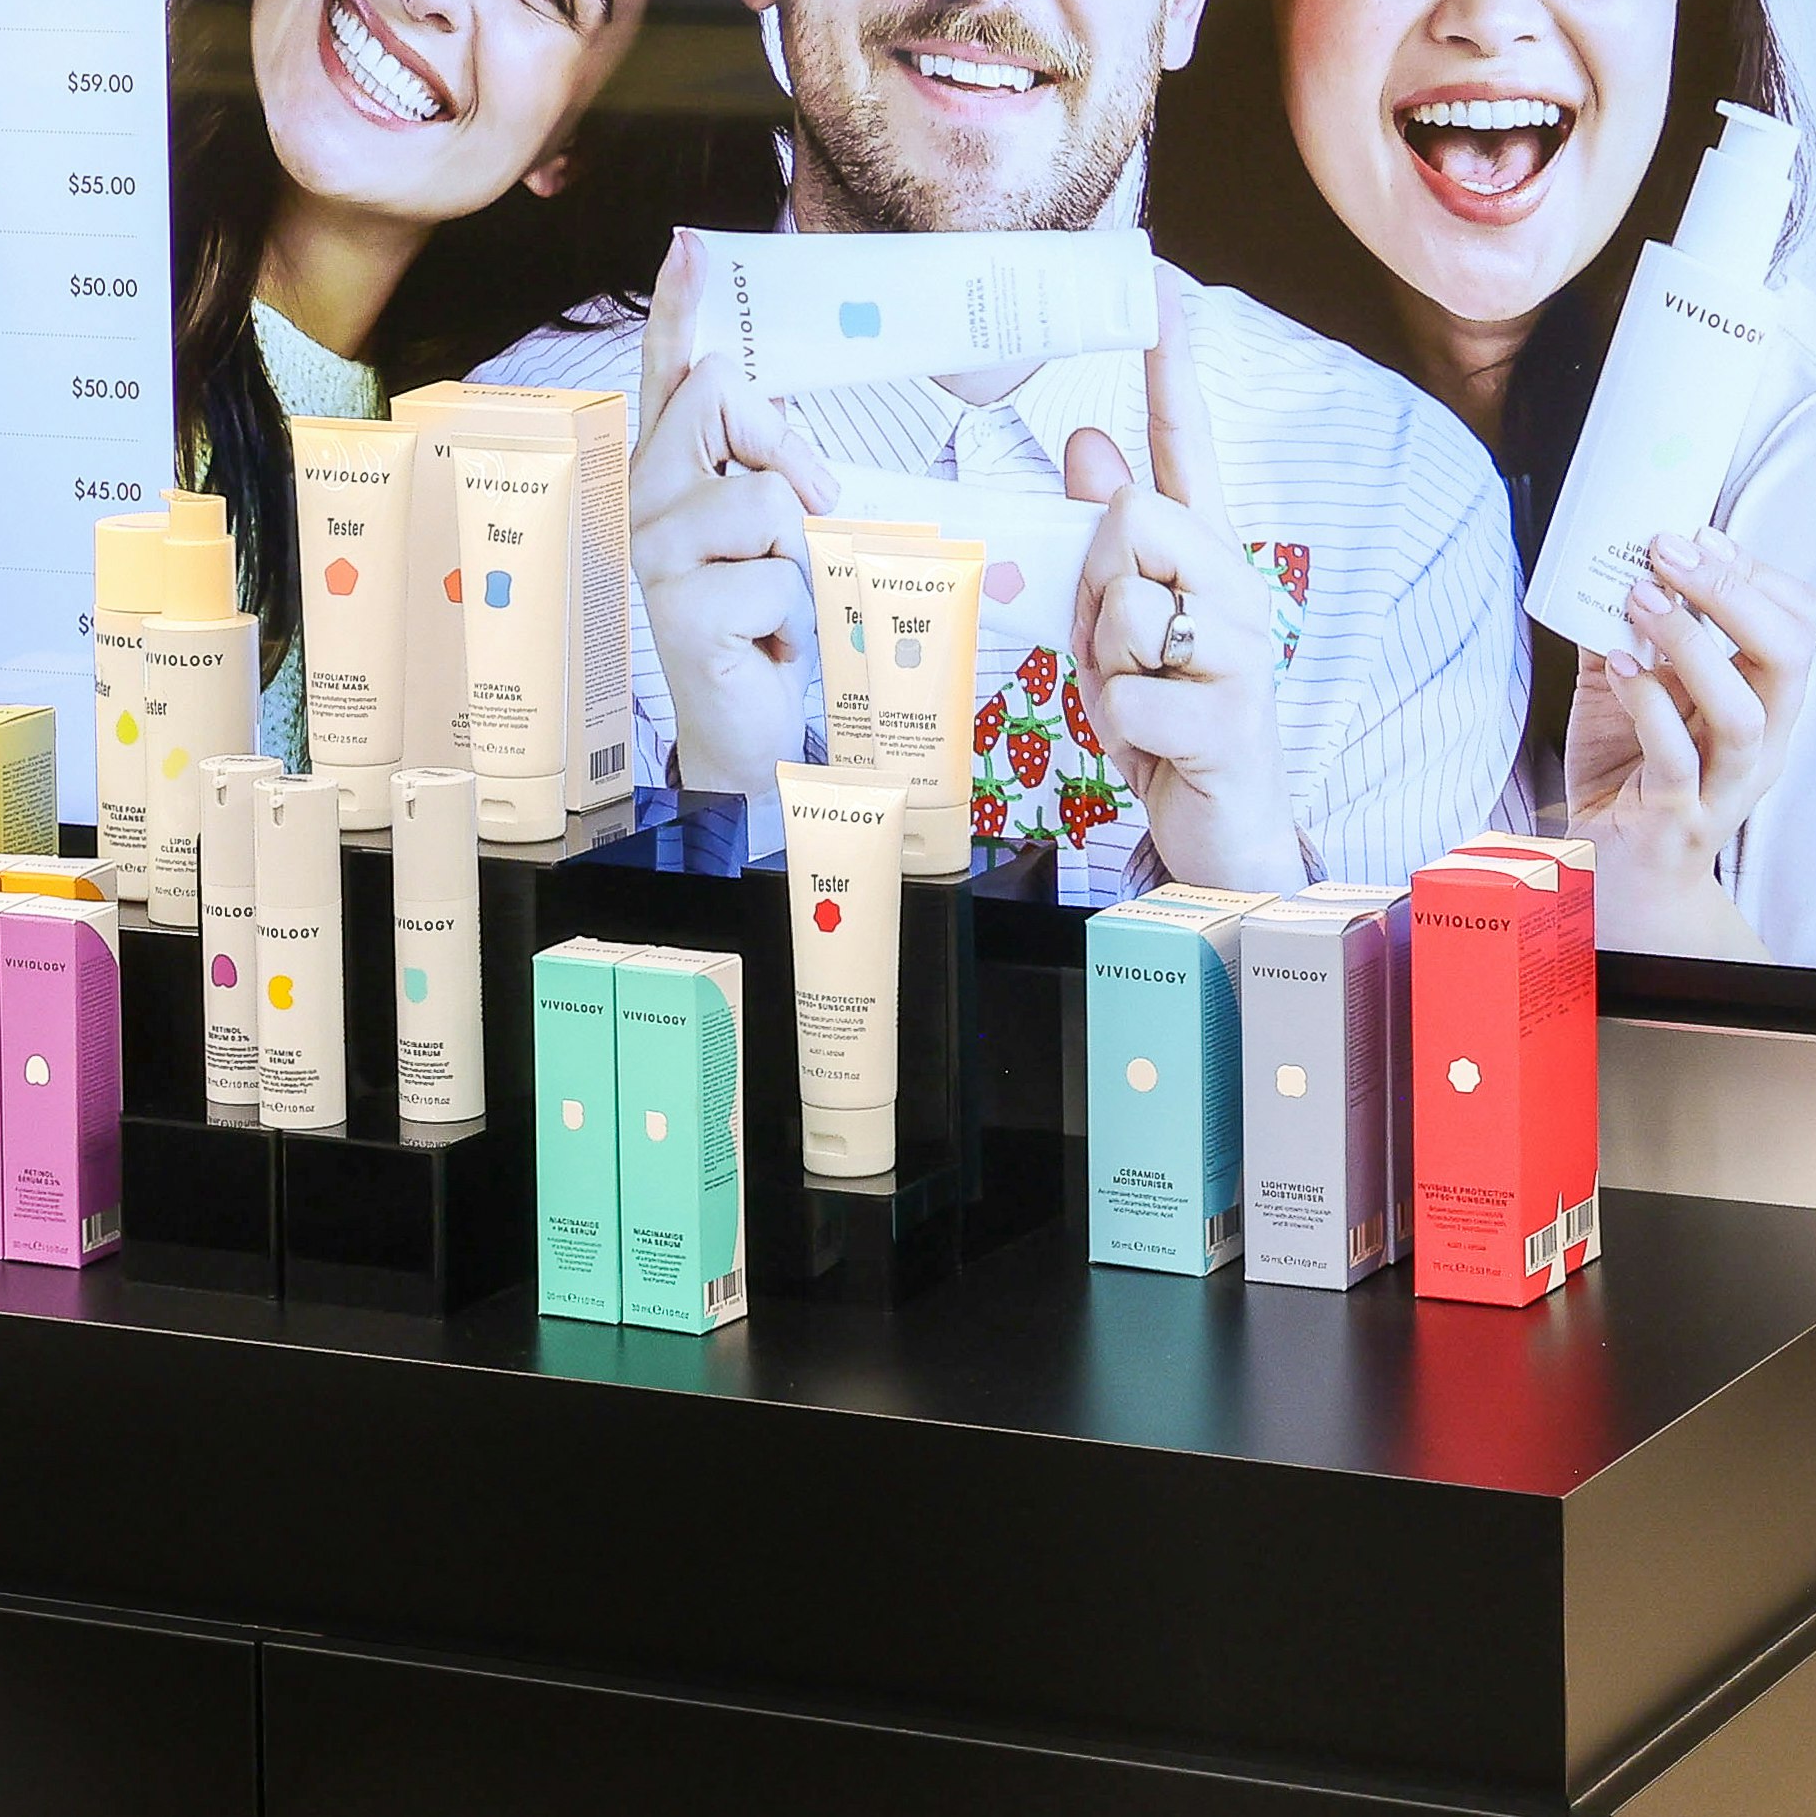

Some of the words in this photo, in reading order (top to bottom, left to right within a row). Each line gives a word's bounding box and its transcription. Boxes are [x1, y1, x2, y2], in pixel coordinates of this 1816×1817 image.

[67, 72, 134, 95] $59.00
[68, 173, 136, 197] $55.00
[70, 276, 138, 299] $50.00
[730, 260, 757, 383] VIVIOLOGY
[1664, 291, 1766, 346] VIVIOLOGY
[71, 378, 140, 401] $50.00
[305, 468, 391, 485] VIVIOLOGY
[466, 476, 550, 495] VIVIOLOGY
[74, 479, 142, 502] $45.00
[327, 517, 365, 537] Tester
[487, 522, 523, 545] Tester
[871, 577, 957, 593] VIVIOLOGY
[891, 616, 932, 635] Tester
[313, 672, 366, 682] EXFOLIATING
[342, 682, 369, 691] MASK
[496, 693, 523, 701] MASK
[879, 711, 937, 721] LIGHTWEIGHT
[879, 719, 937, 730] MOISTURISER
[792, 803, 886, 826] VIVIOLOGY
[811, 873, 850, 893] Tester
[1415, 911, 1511, 933] VIVIOLOGY
[5, 957, 67, 973] VIVIOLOGY
[1095, 963, 1188, 985] VIVIOLOGY
[1251, 966, 1328, 983] VIVIOLOGY
[540, 998, 605, 1016] VIVIOLOGY
[819, 1003, 868, 1012] SUNSCREEN
[821, 995, 876, 1004] PROTECTION
[623, 1009, 688, 1028] VIVIOLOGY
[1112, 1176, 1174, 1190] MOISTURISER
[1119, 1168, 1167, 1180] CERAMIDE
[1260, 1180, 1325, 1194] LIGHTWEIGHT
[1261, 1189, 1325, 1204] MOISTURISER
